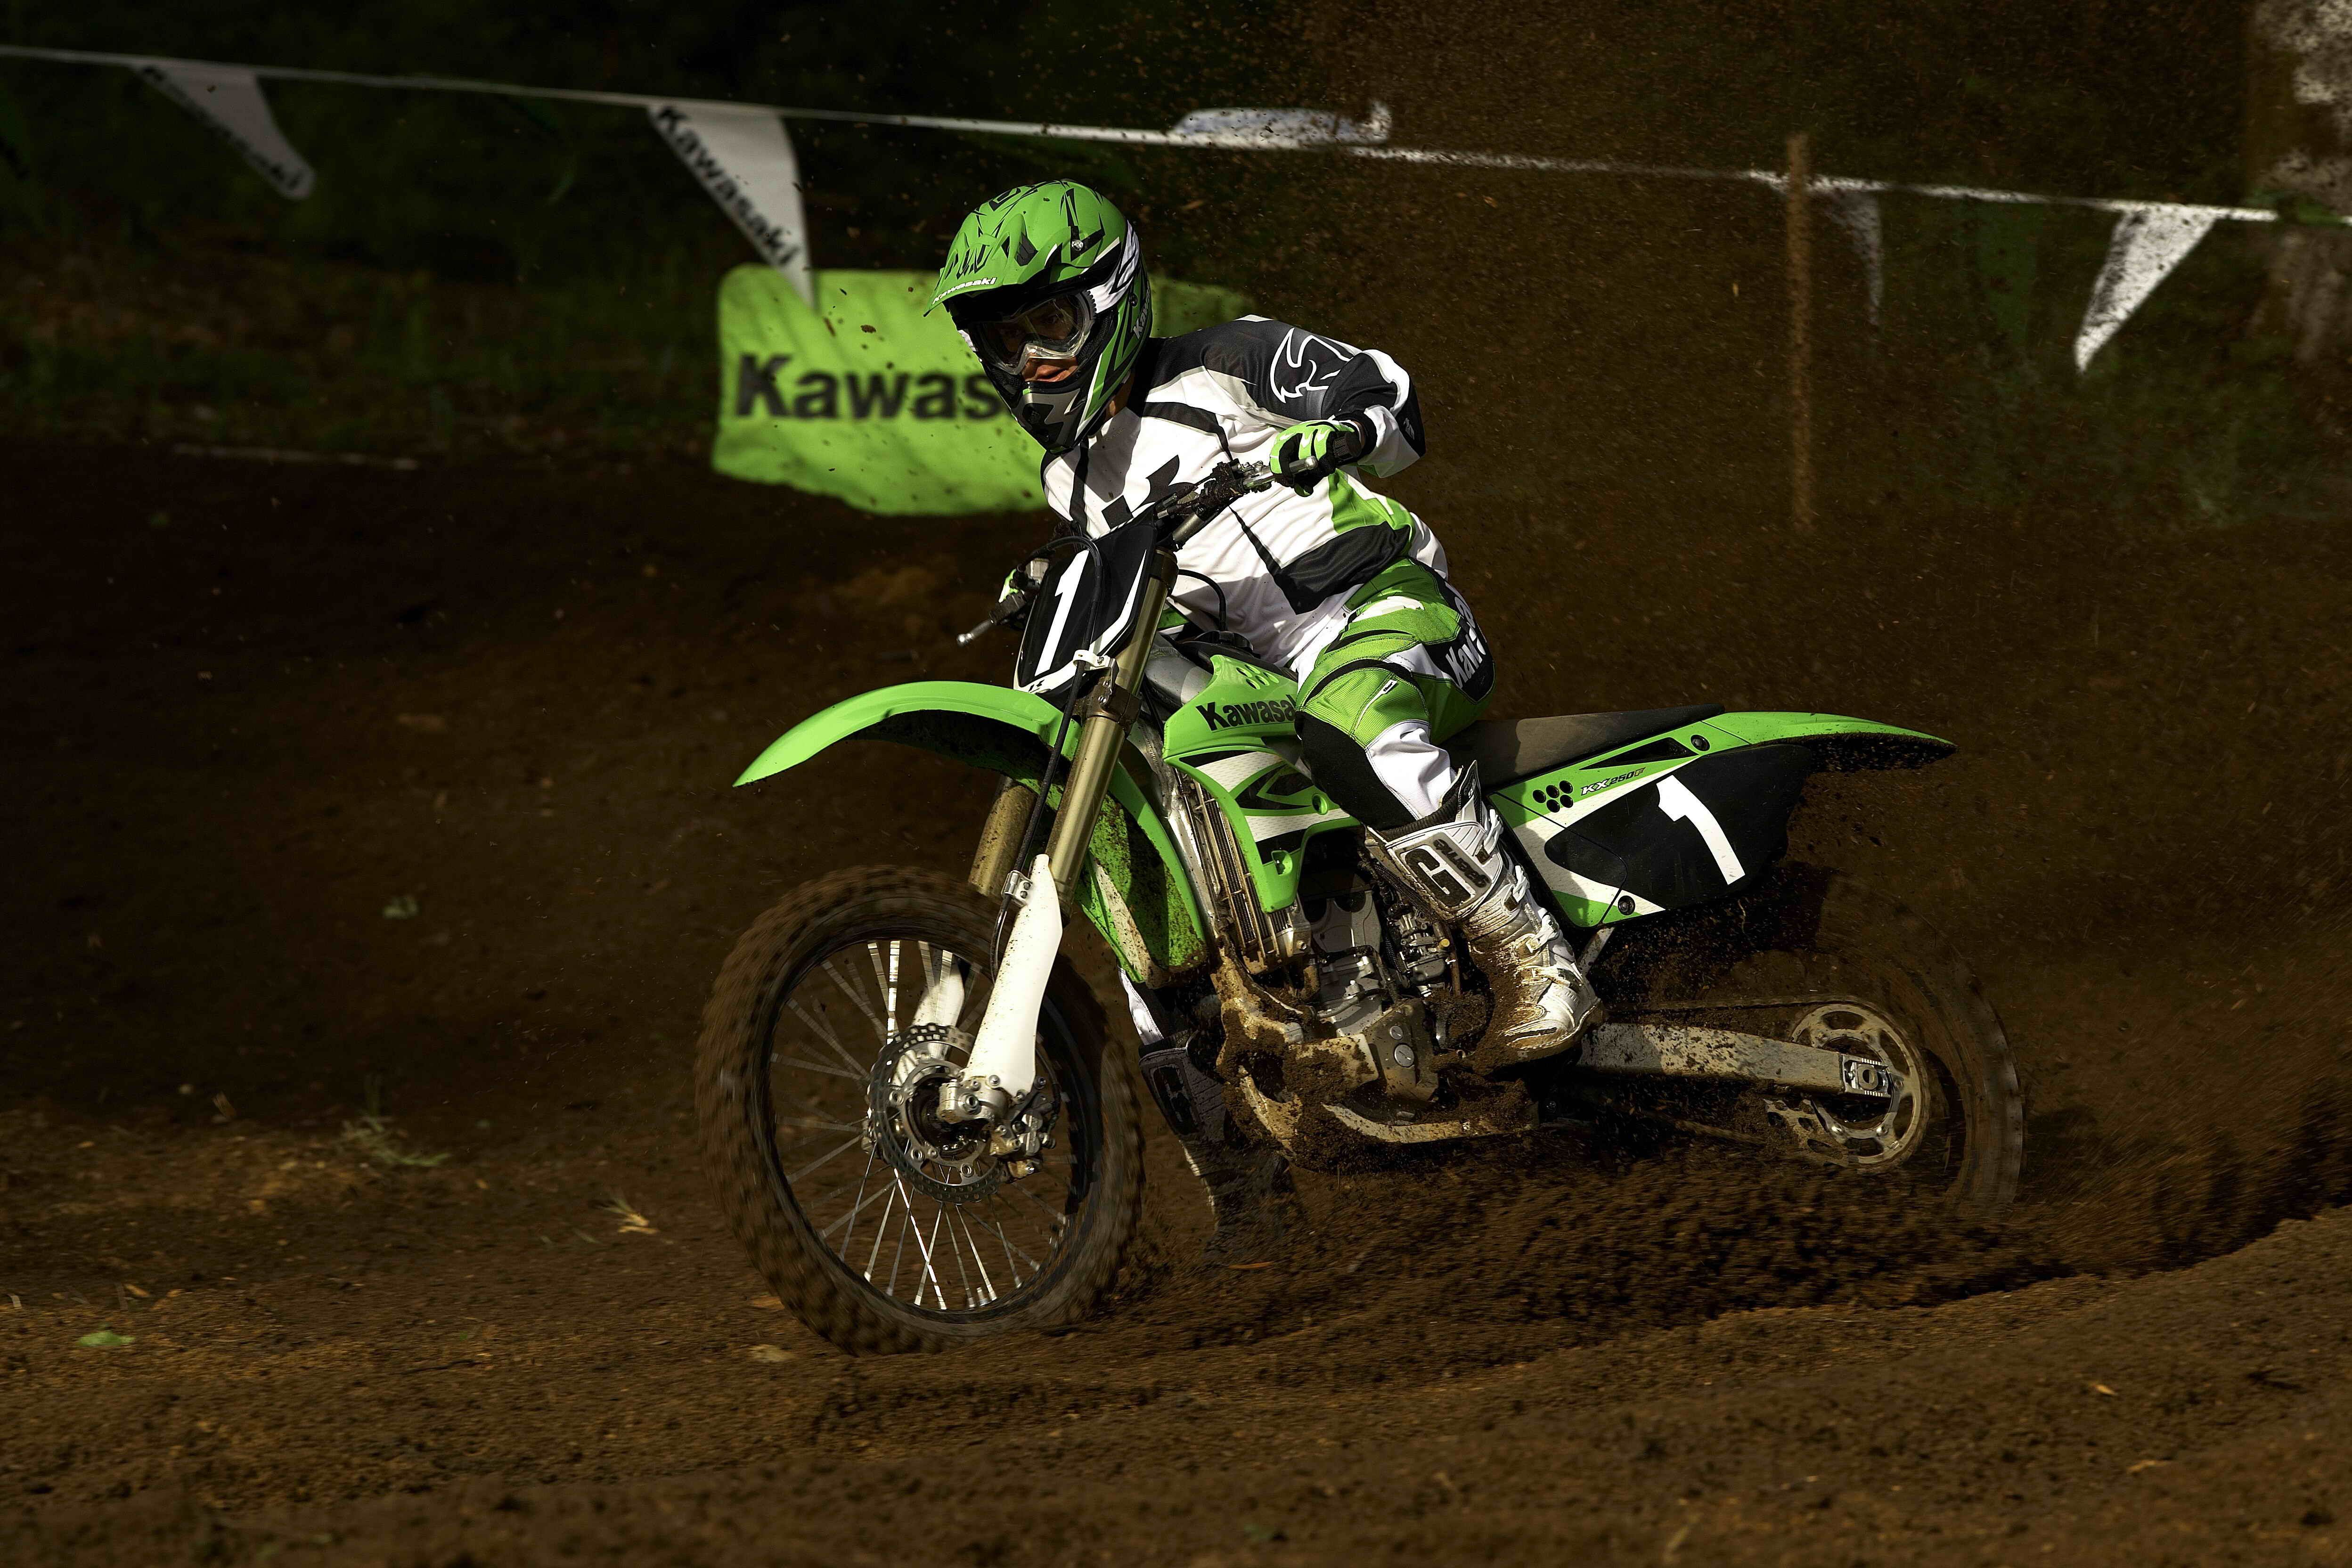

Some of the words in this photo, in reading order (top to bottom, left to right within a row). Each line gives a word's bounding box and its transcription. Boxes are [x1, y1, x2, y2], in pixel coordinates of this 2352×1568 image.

[735, 352, 1003, 419] Kawas
[1035, 549, 1090, 676] 1
[1581, 767, 1646, 796] KX250F
[1656, 775, 1746, 885] 1
